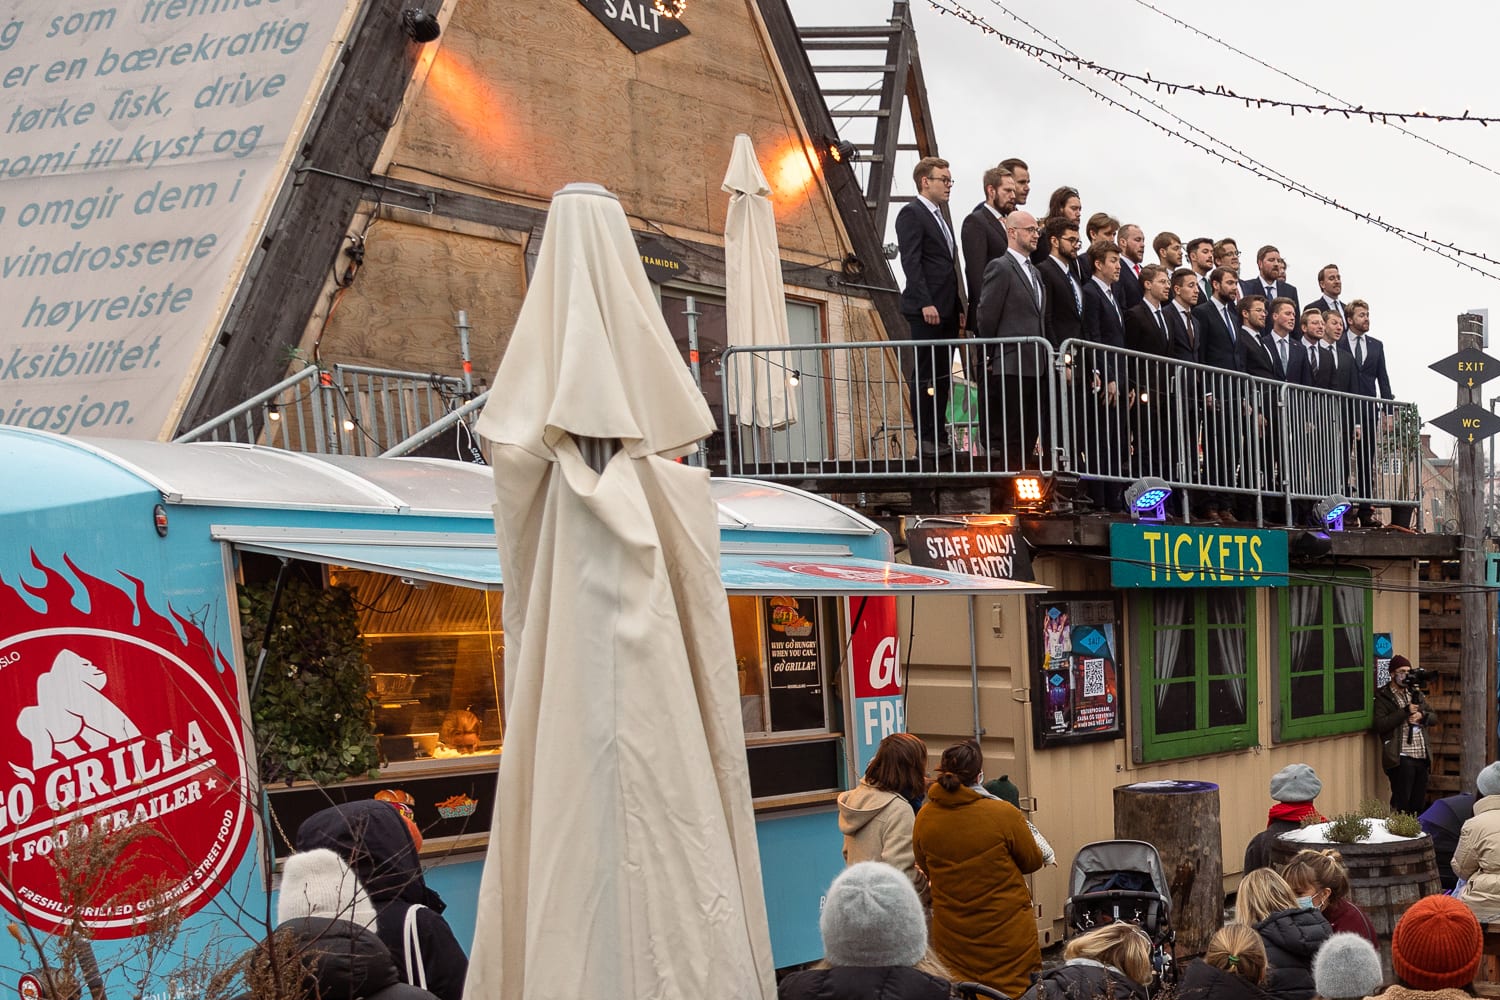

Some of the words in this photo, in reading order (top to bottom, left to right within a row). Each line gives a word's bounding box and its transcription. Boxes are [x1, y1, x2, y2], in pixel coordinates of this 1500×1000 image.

[46, 7, 116, 38] som
[604, 0, 664, 34] SALT
[3, 63, 40, 88] er
[44, 57, 88, 83] en
[94, 18, 310, 76] bærekraftig
[6, 98, 96, 133] tørke
[108, 85, 172, 120] fisk,
[194, 72, 286, 109] drive
[84, 137, 122, 169] til
[127, 126, 204, 170] kyst
[213, 125, 264, 158] og
[18, 186, 124, 230] omgir
[134, 181, 218, 215] dem
[228, 169, 246, 203] i
[2, 233, 217, 279] vindrossene
[640, 255, 679, 270] YRAMIDEN
[22, 282, 193, 332] høyreiste
[0, 335, 162, 380] ksibilitet.
[1458, 362, 1484, 372] EXIT
[1462, 418, 1481, 428] WC
[926, 536, 971, 559] STAFF
[976, 534, 1017, 555] ONLY!
[946, 558, 969, 575] NO
[970, 556, 1013, 578] ENTRY
[1143, 531, 1263, 582] TICKETS
[0, 651, 21, 669] SLO
[45, 719, 213, 811] GRILLA
[99, 780, 203, 836] TRAILER
[18, 886, 72, 914] FRESHLY
[193, 844, 224, 882] STREET
[217, 808, 235, 843] FOOD
